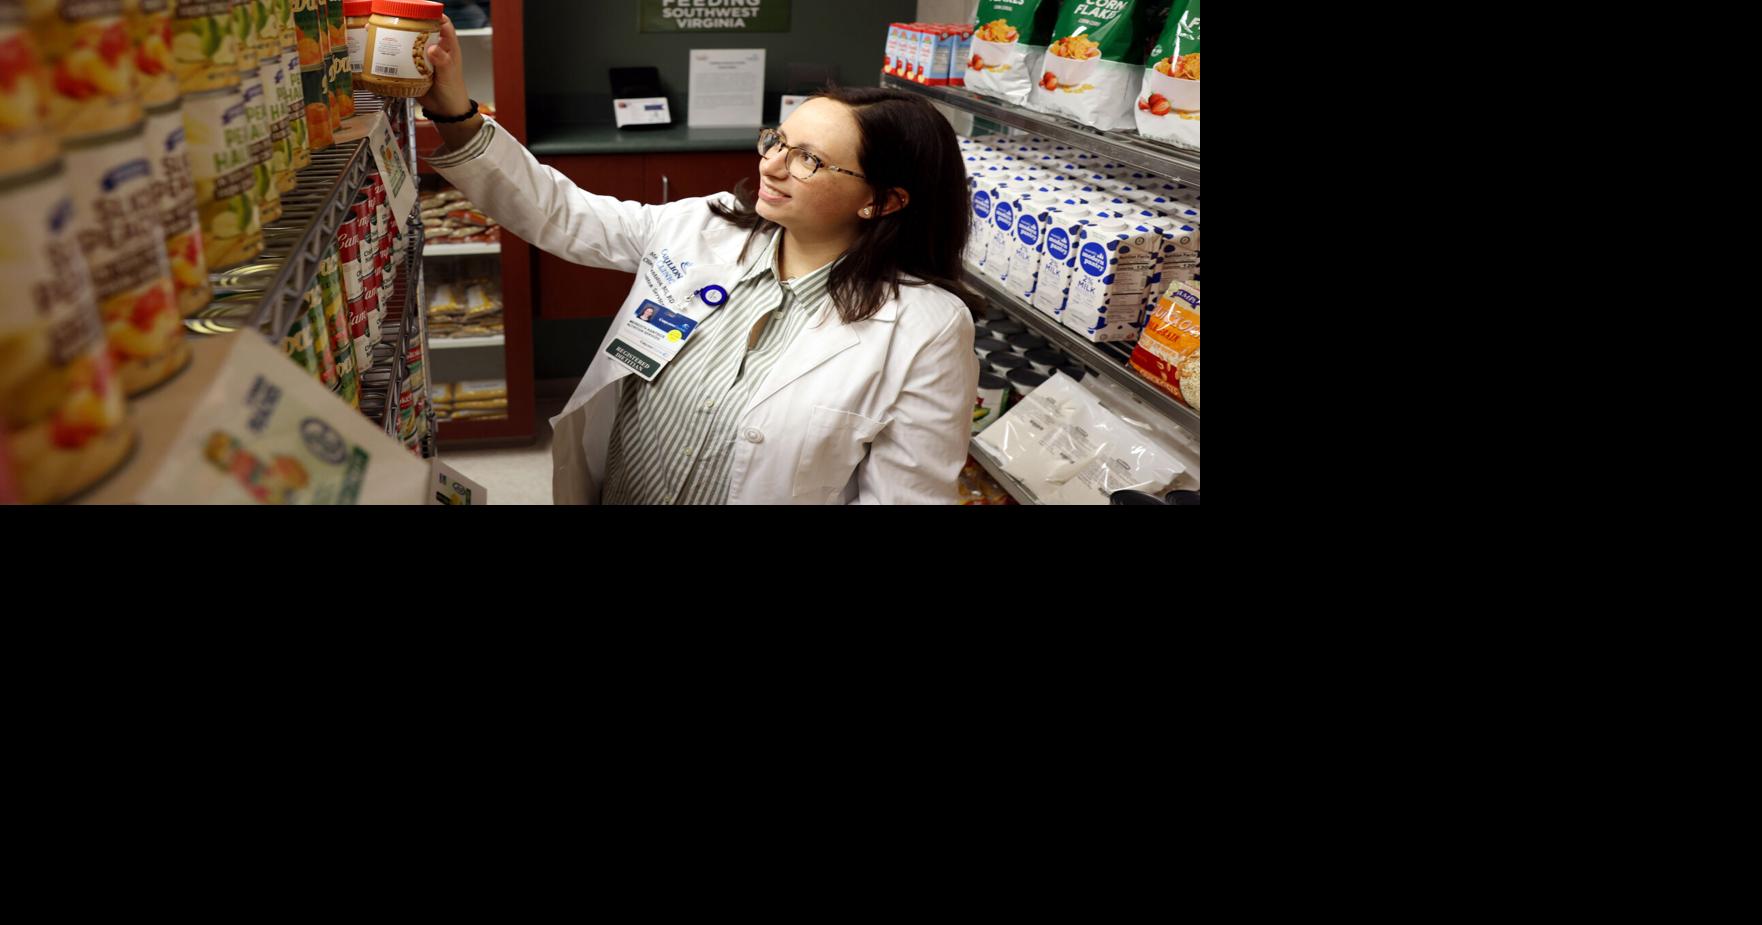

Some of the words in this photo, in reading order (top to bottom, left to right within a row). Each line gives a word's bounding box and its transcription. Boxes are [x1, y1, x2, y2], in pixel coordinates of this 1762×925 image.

[662, 7, 761, 18] SOUTHWEST
[1073, 4, 1120, 19] FLAKE
[676, 18, 747, 29] VIRGINIA
[1078, 281, 1096, 295] MILK
[615, 346, 651, 370] REGISTERED
